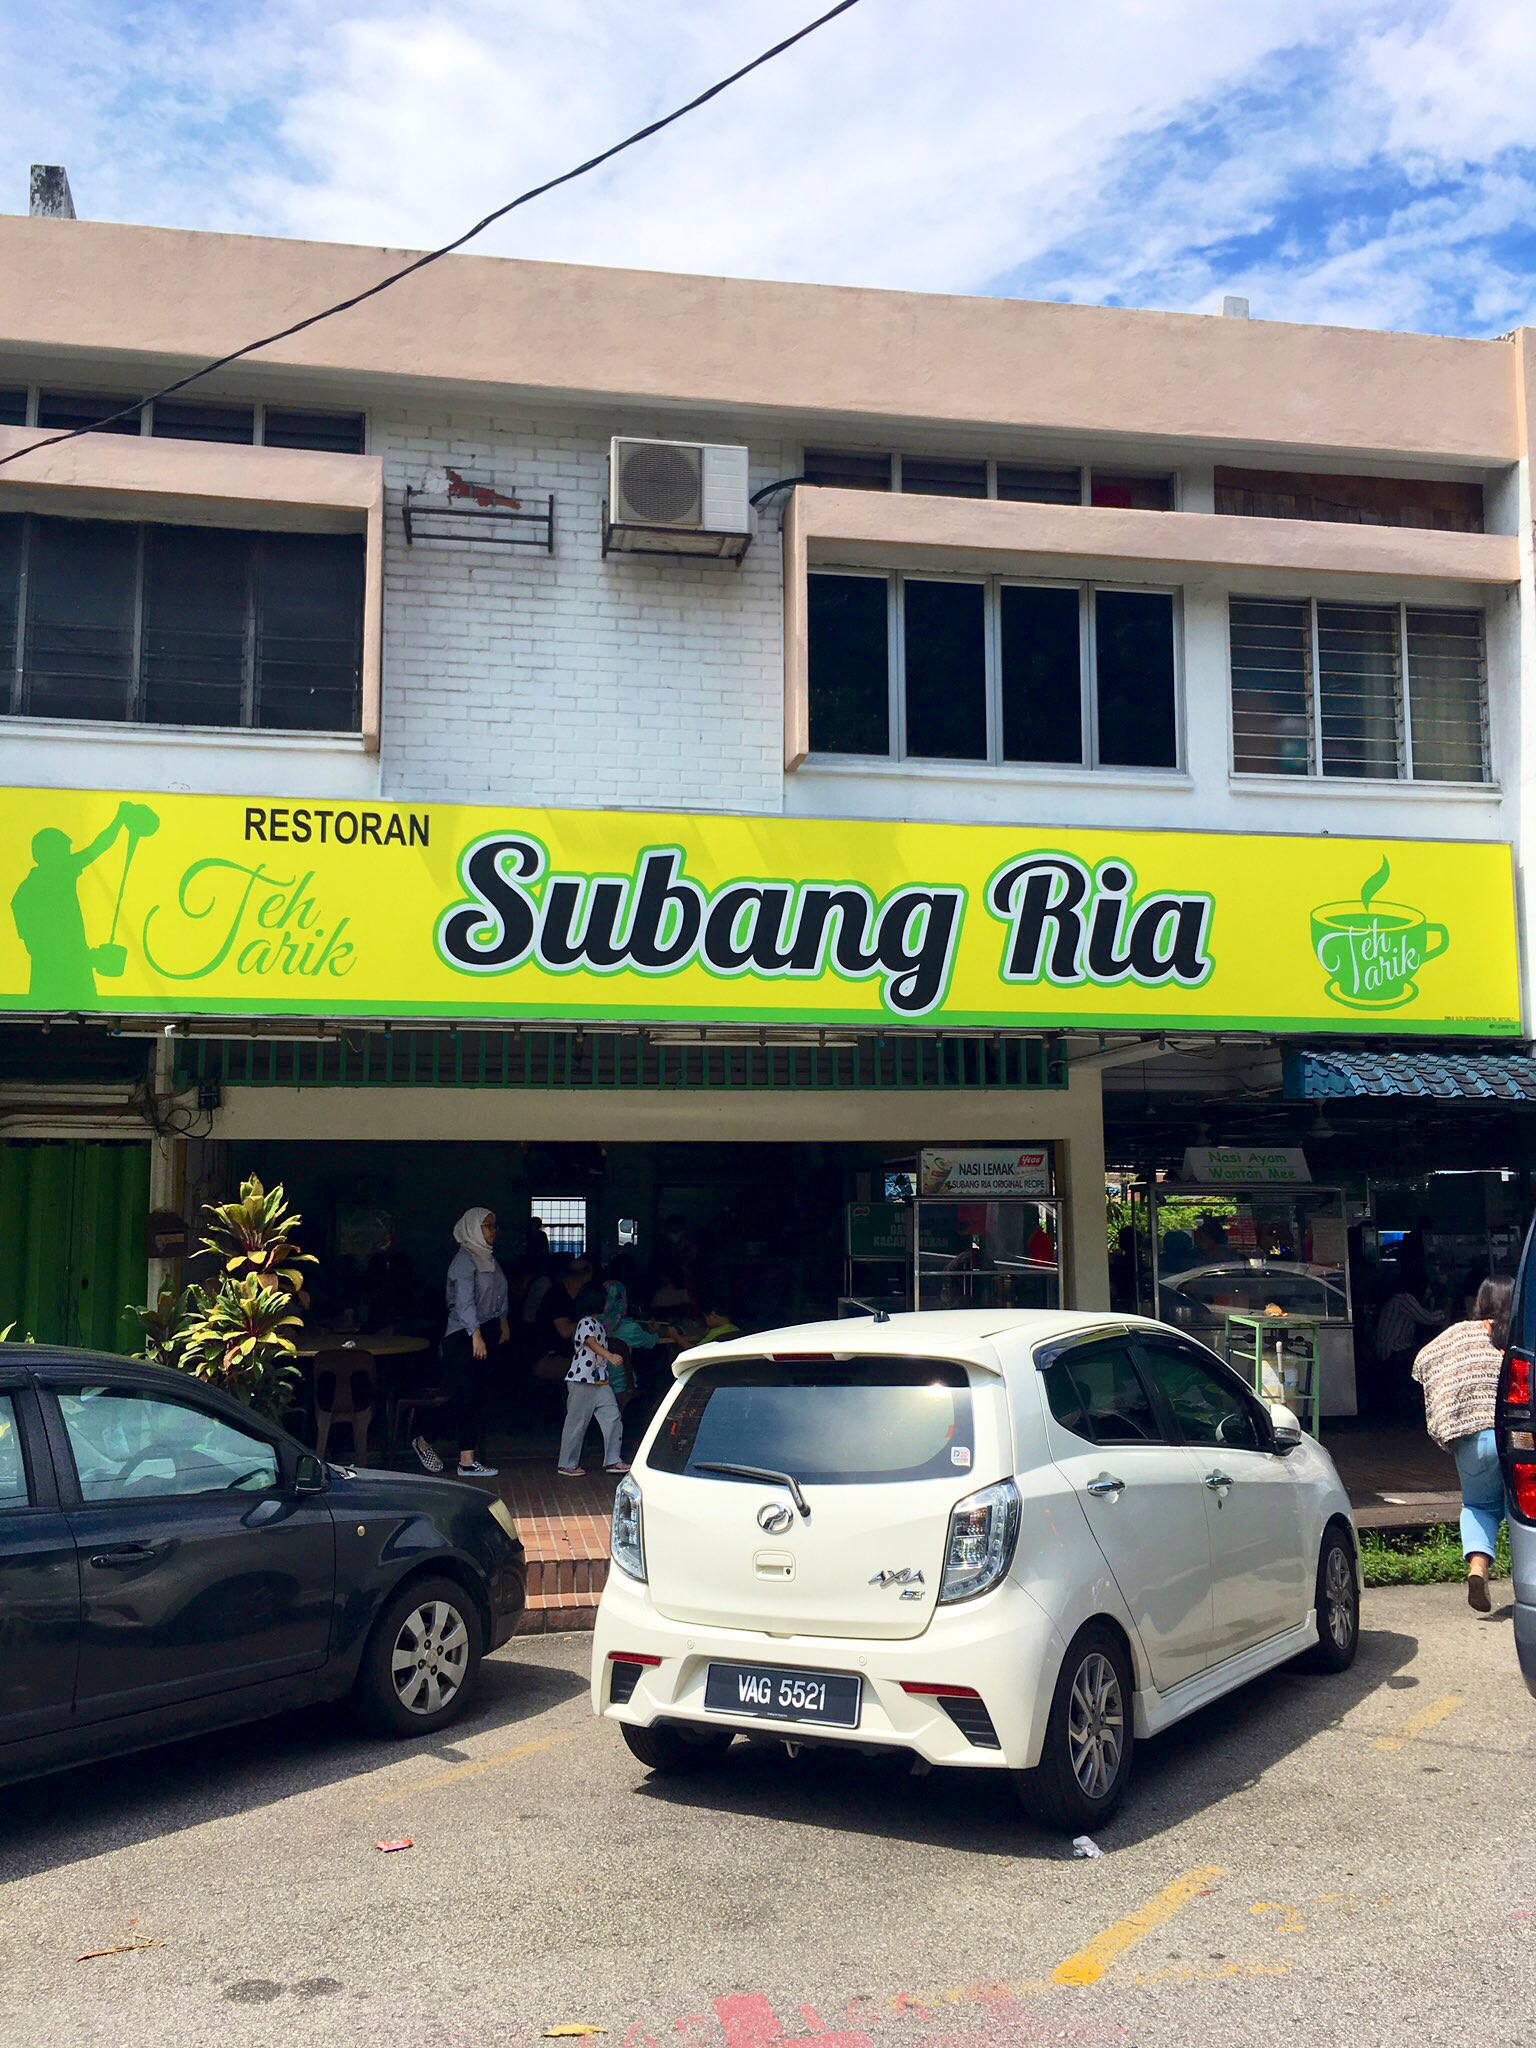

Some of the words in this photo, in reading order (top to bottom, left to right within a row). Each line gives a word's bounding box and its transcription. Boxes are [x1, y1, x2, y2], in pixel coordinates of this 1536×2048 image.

[244, 807, 430, 847] RESTORAN
[441, 838, 961, 1013] Subang
[990, 856, 1210, 983] Ria
[1317, 918, 1391, 992] Teh
[959, 1163, 980, 1175] NASI
[983, 1163, 1014, 1175] LEMAK
[1208, 1151, 1241, 1163] Nasi
[1249, 1152, 1287, 1167] Ayam
[1268, 1167, 1296, 1179] Mee
[952, 1180, 980, 1189] SUBANG
[981, 1180, 991, 1189] RIA
[992, 1180, 1022, 1189] ORIGINAL
[1024, 1180, 1045, 1189] RECIPE
[867, 1567, 926, 1588] AXIA
[738, 1674, 772, 1705] VAG
[778, 1679, 827, 1711] 5521
